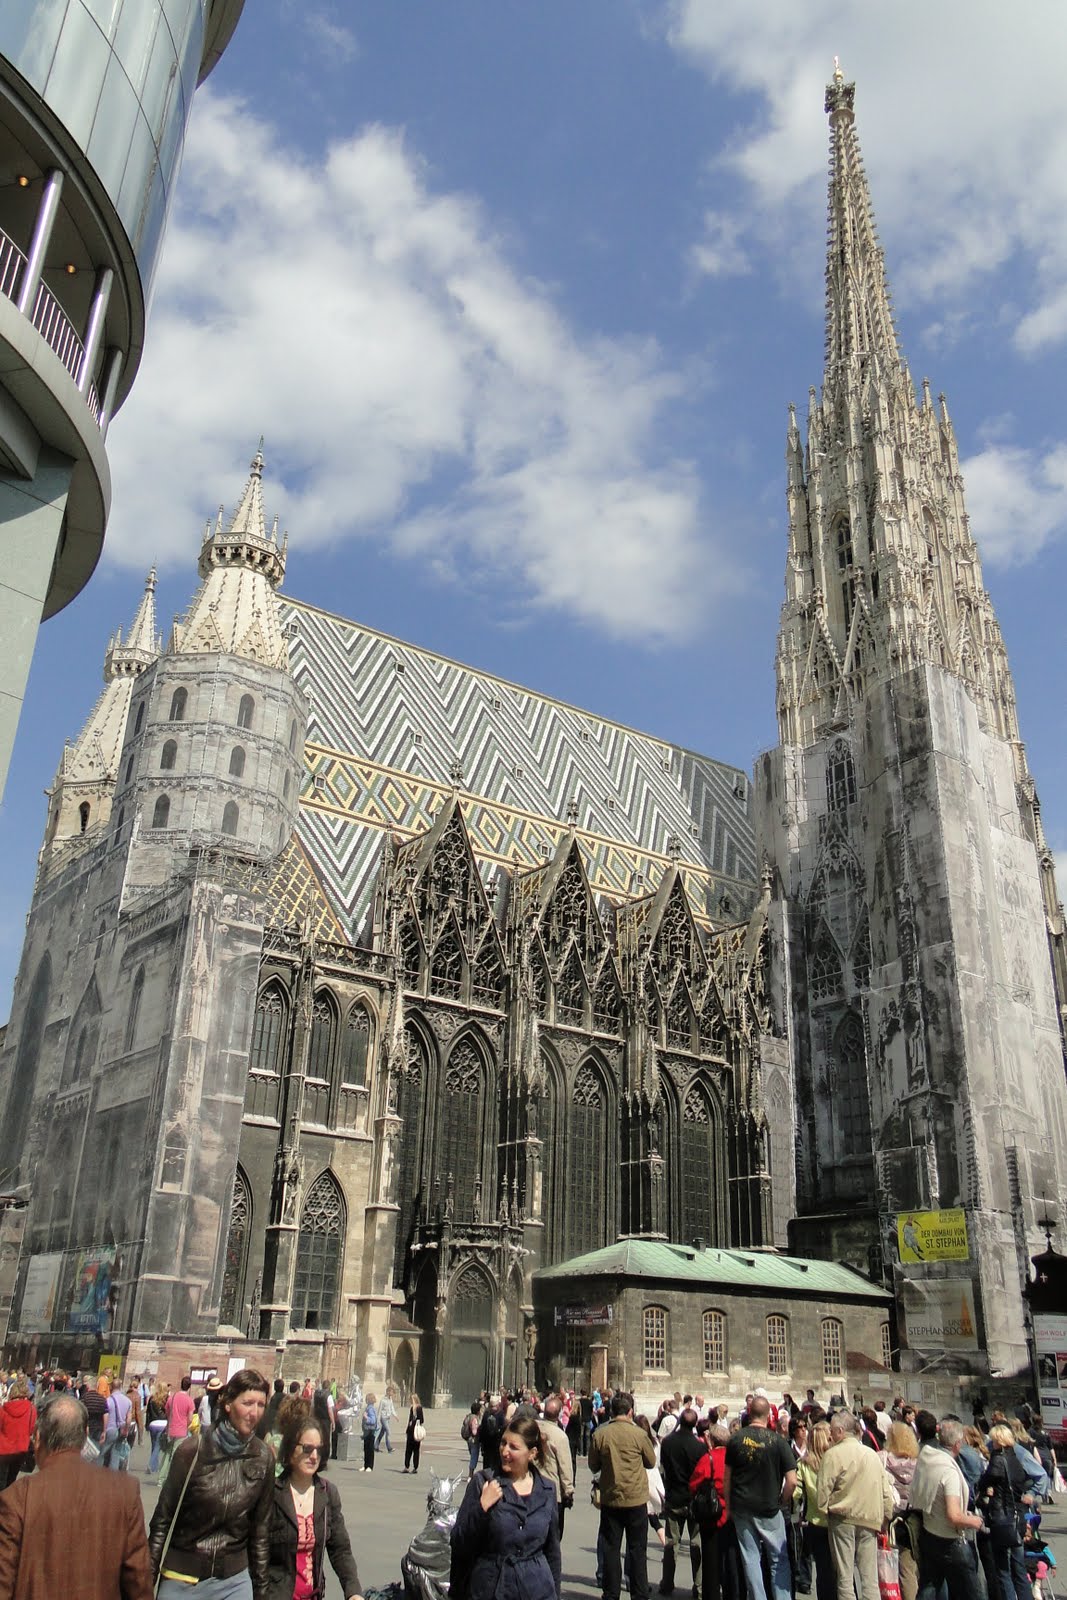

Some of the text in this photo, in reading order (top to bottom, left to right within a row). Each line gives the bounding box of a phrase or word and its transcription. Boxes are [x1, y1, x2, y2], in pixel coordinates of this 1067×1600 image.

[921, 1227, 965, 1238] DER DOMBAU VON
[925, 1237, 966, 1249] ST. STEPHAN
[948, 1319, 971, 1327] UNSER
[908, 1327, 973, 1336] STEPHANSDOM
